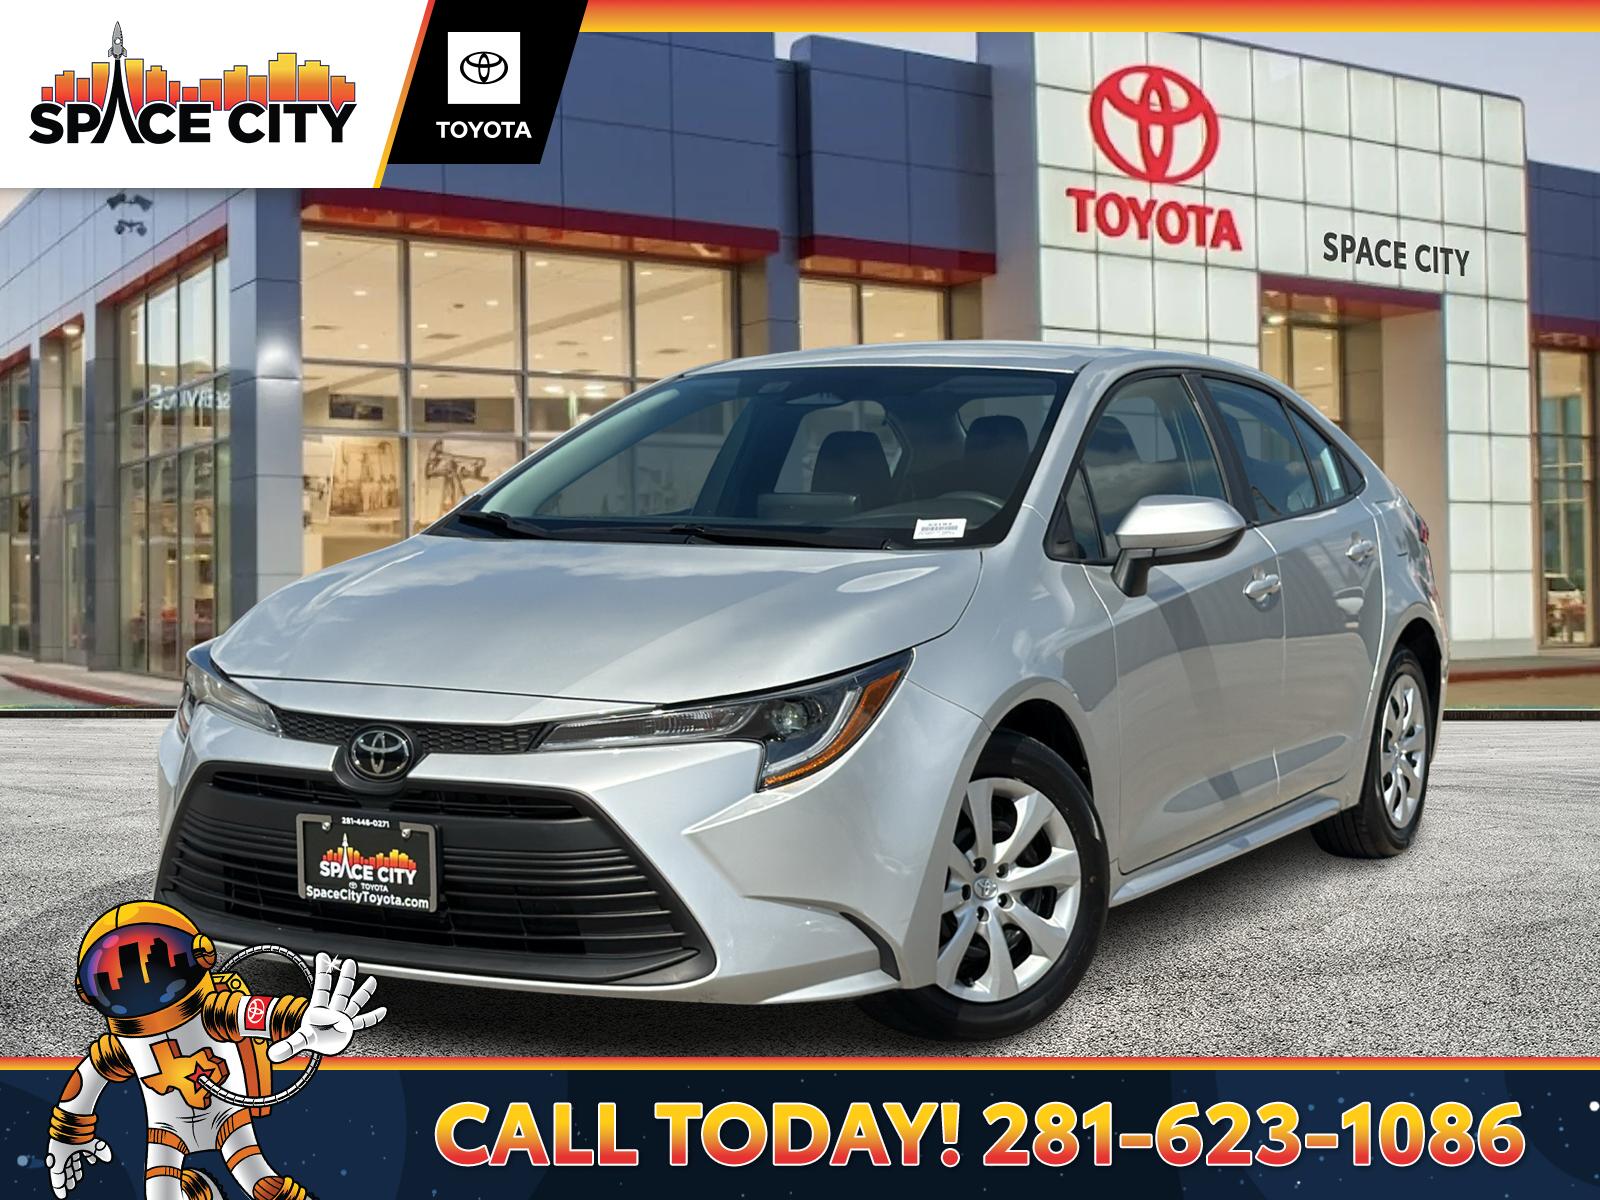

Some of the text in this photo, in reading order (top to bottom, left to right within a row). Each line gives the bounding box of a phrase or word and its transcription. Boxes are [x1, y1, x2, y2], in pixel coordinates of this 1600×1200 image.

[1066, 187, 1242, 251] TOYOTA
[1323, 232, 1470, 277] SPACE CITY
[319, 860, 417, 885] SPACE CITY
[306, 885, 429, 909] SpaceCityToyota.com
[361, 883, 389, 892] TOYOTA
